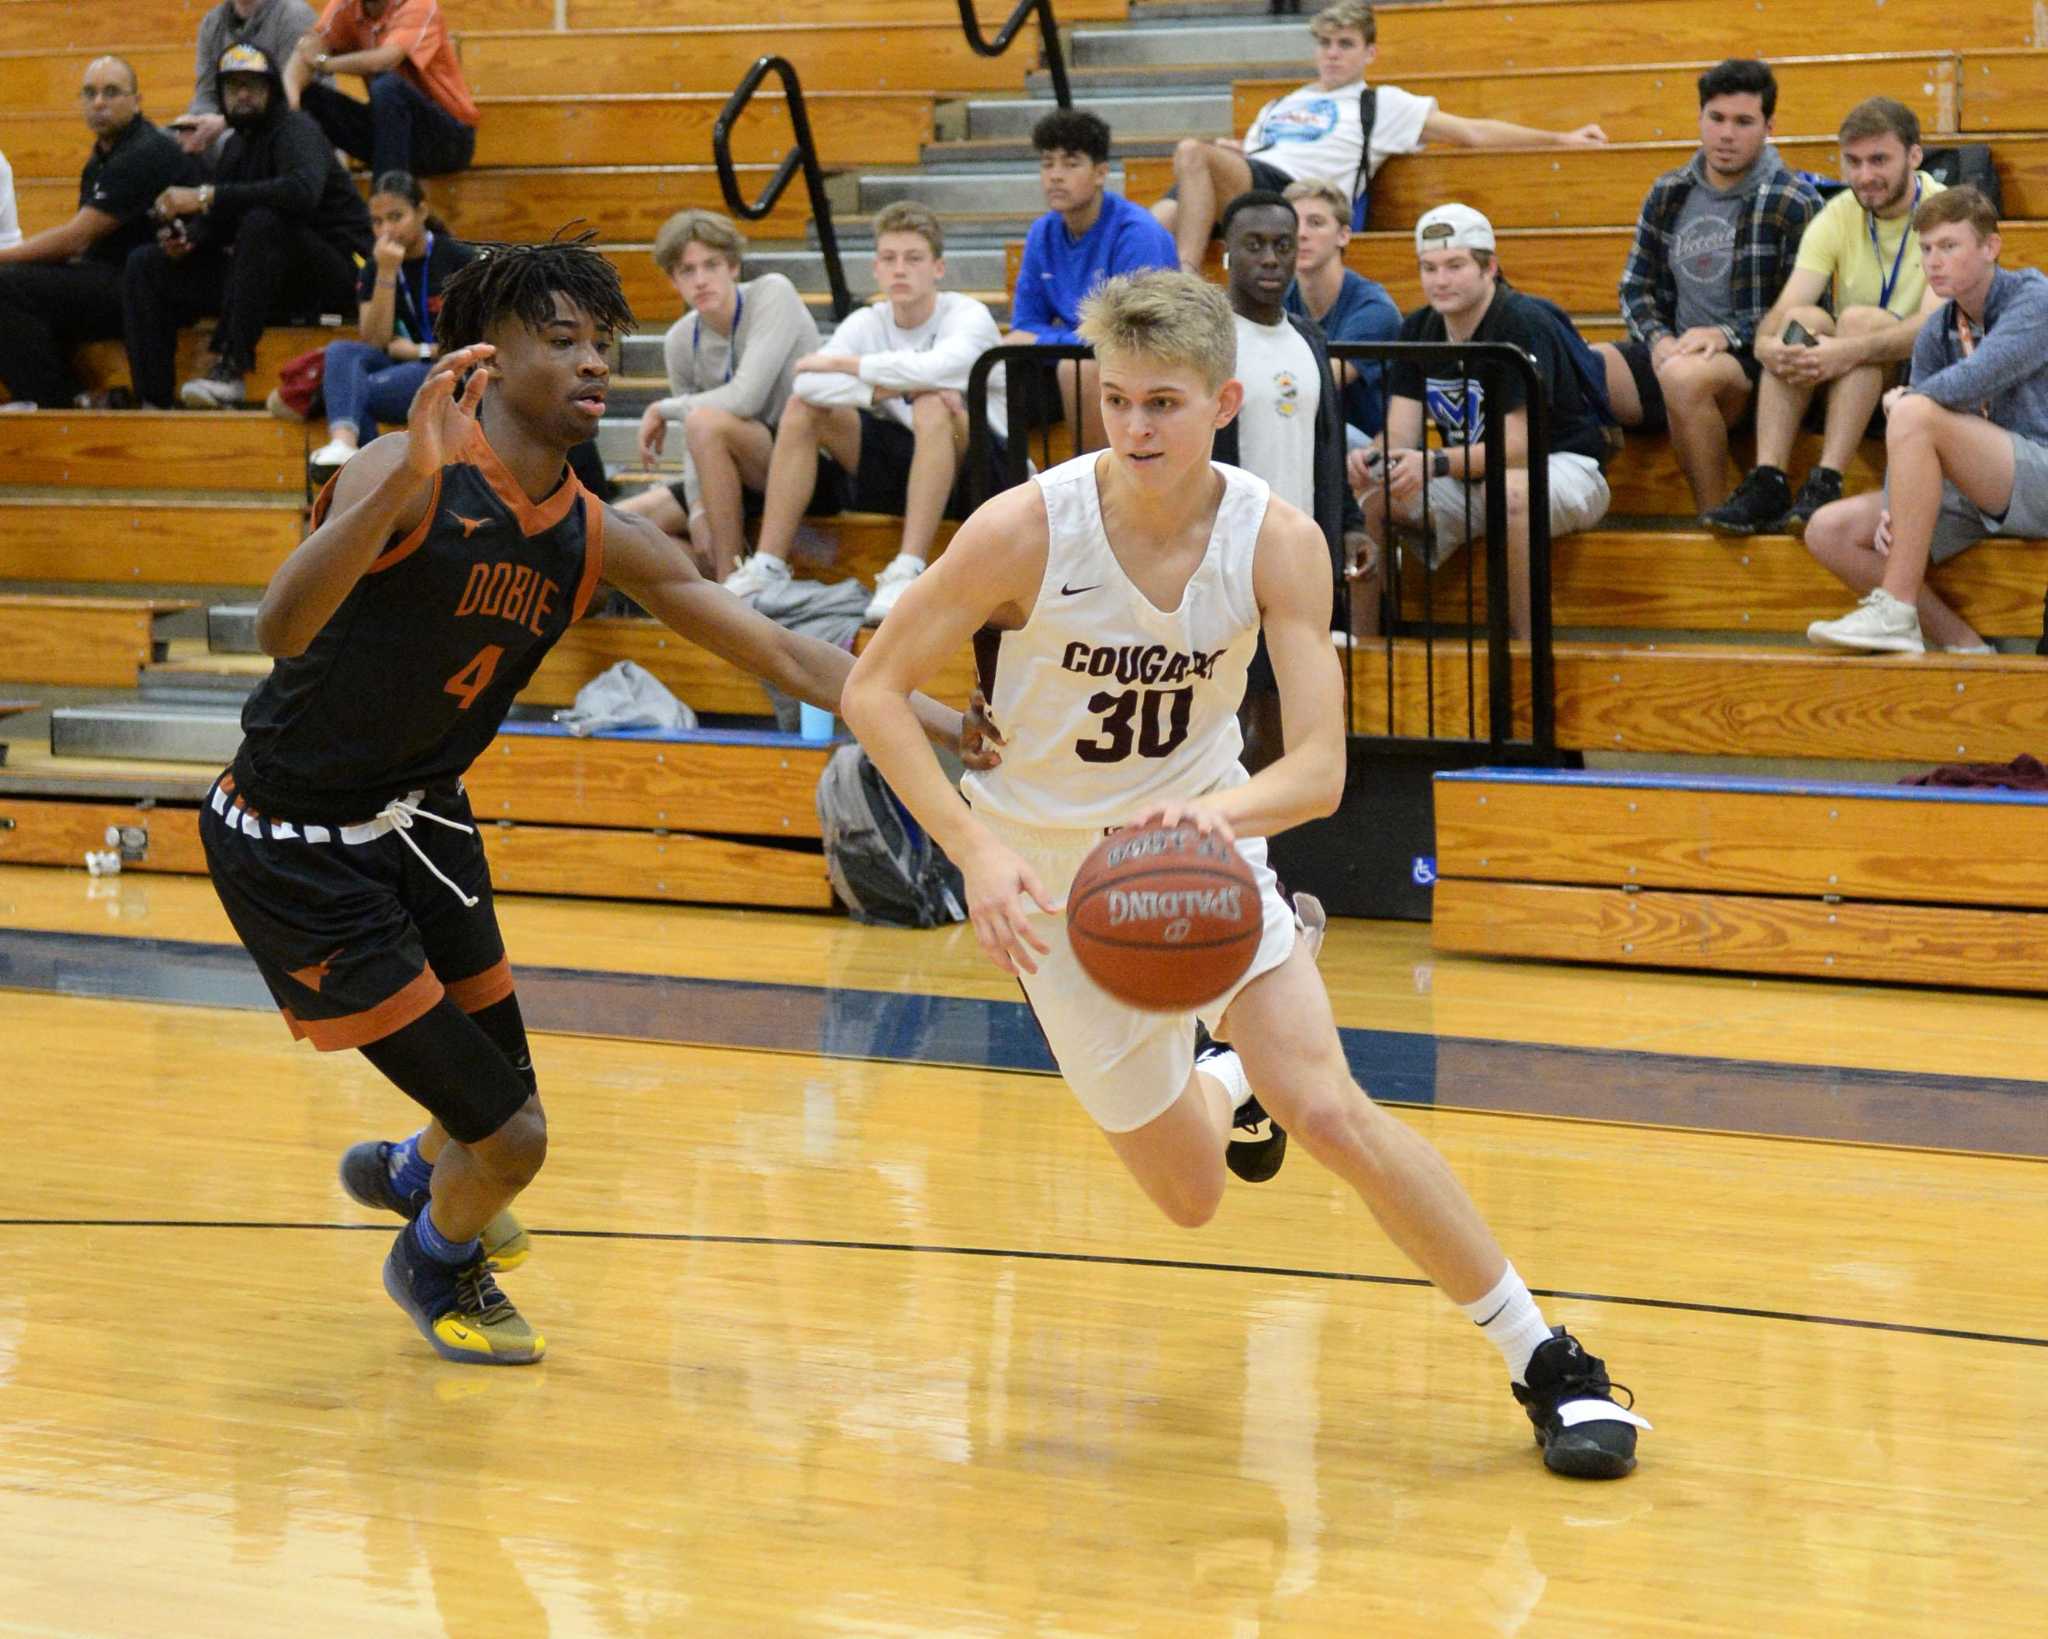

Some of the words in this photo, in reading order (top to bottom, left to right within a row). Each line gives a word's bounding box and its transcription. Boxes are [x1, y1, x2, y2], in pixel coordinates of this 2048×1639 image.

[455, 563, 559, 636] DOBIE
[444, 645, 504, 709] 4
[1075, 685, 1193, 763] 30
[1108, 886, 1242, 926] SPALDING
